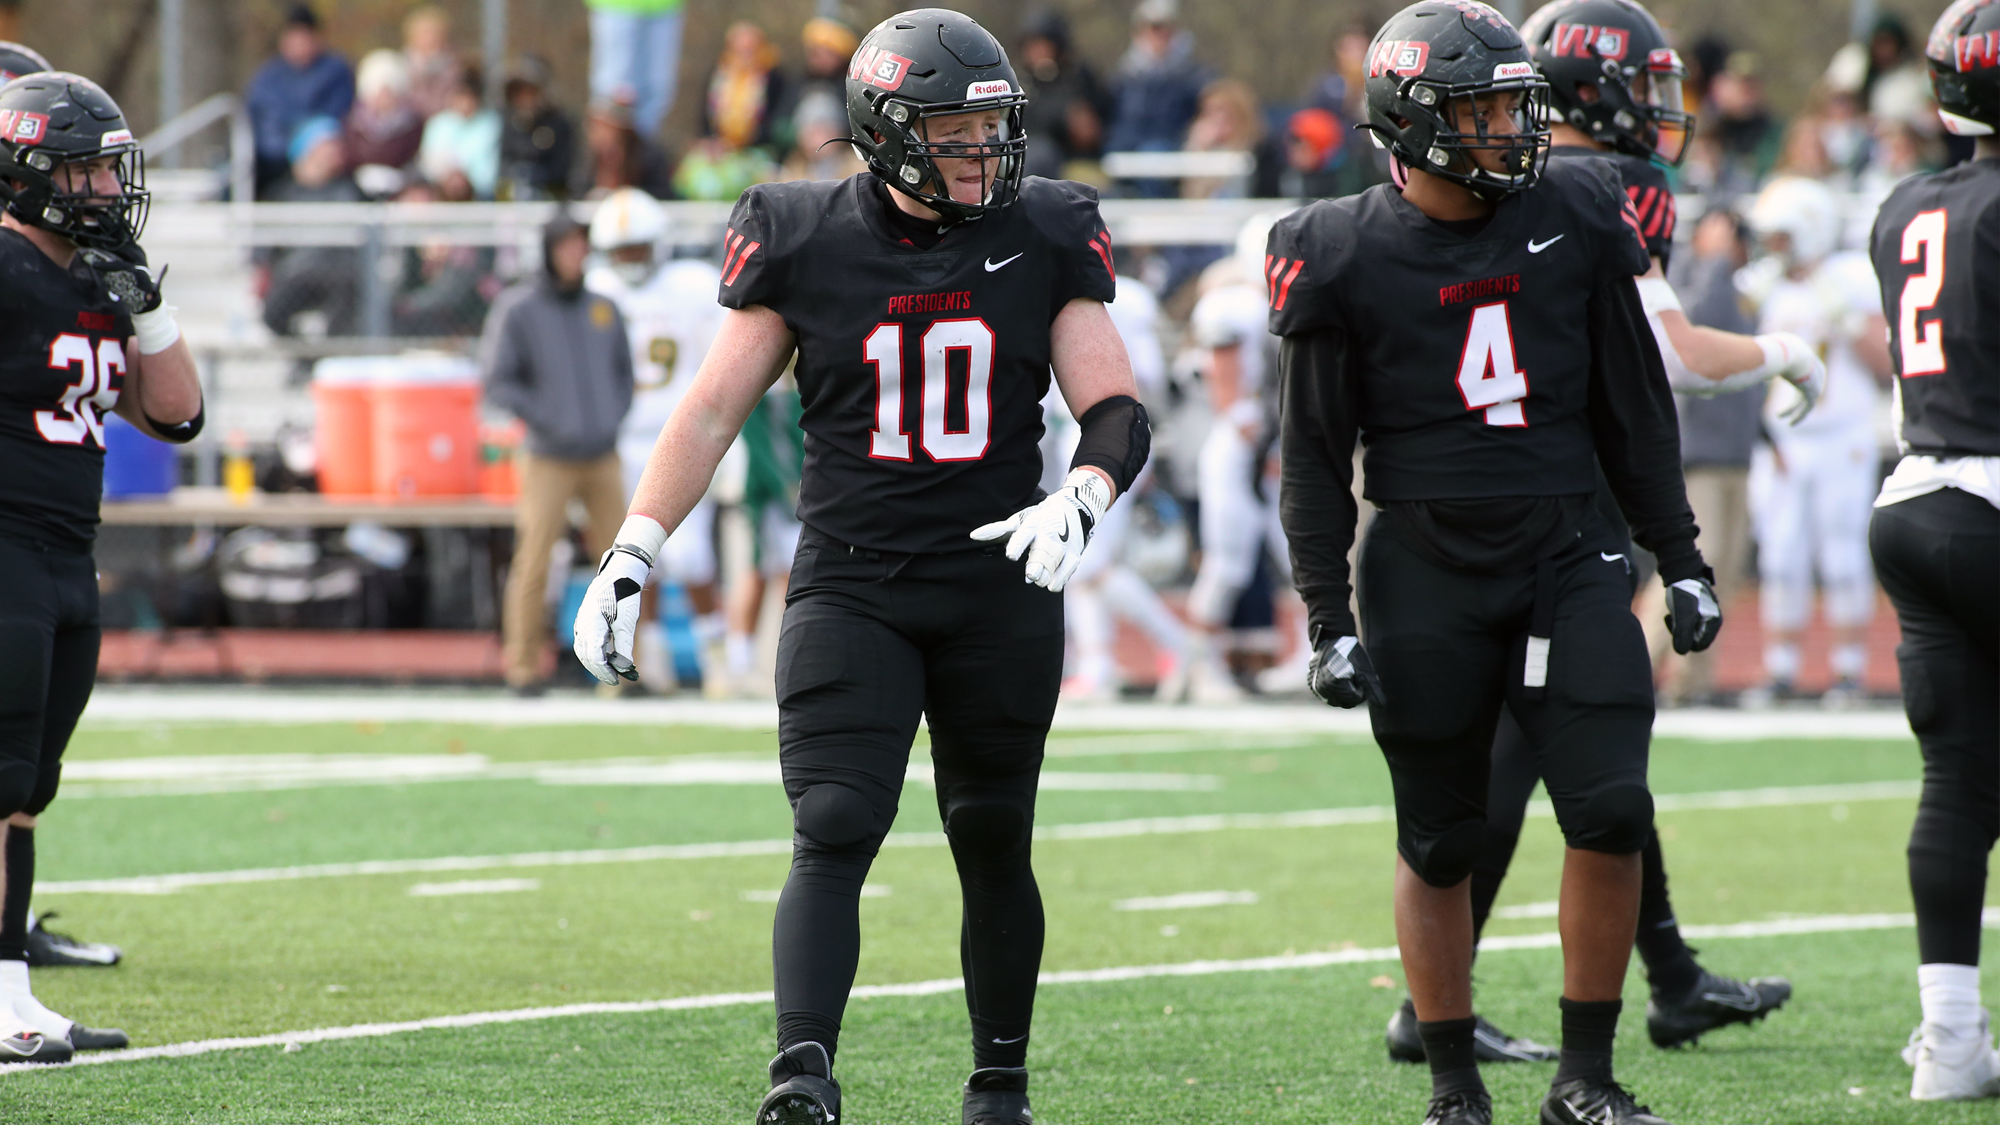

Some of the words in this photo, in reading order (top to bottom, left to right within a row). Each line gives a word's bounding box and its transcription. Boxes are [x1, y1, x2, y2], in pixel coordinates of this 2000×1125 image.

[851, 45, 914, 92] W&J
[1370, 40, 1430, 78] W&J
[1501, 66, 1530, 76] Riddell
[974, 82, 1008, 95] Riddell
[888, 291, 971, 315] PRESIDENTS
[1440, 274, 1520, 306] PRESIDENTS
[1899, 207, 1947, 378] 2
[1454, 300, 1530, 428] 4
[33, 331, 127, 450] 36
[863, 317, 996, 463] 10
